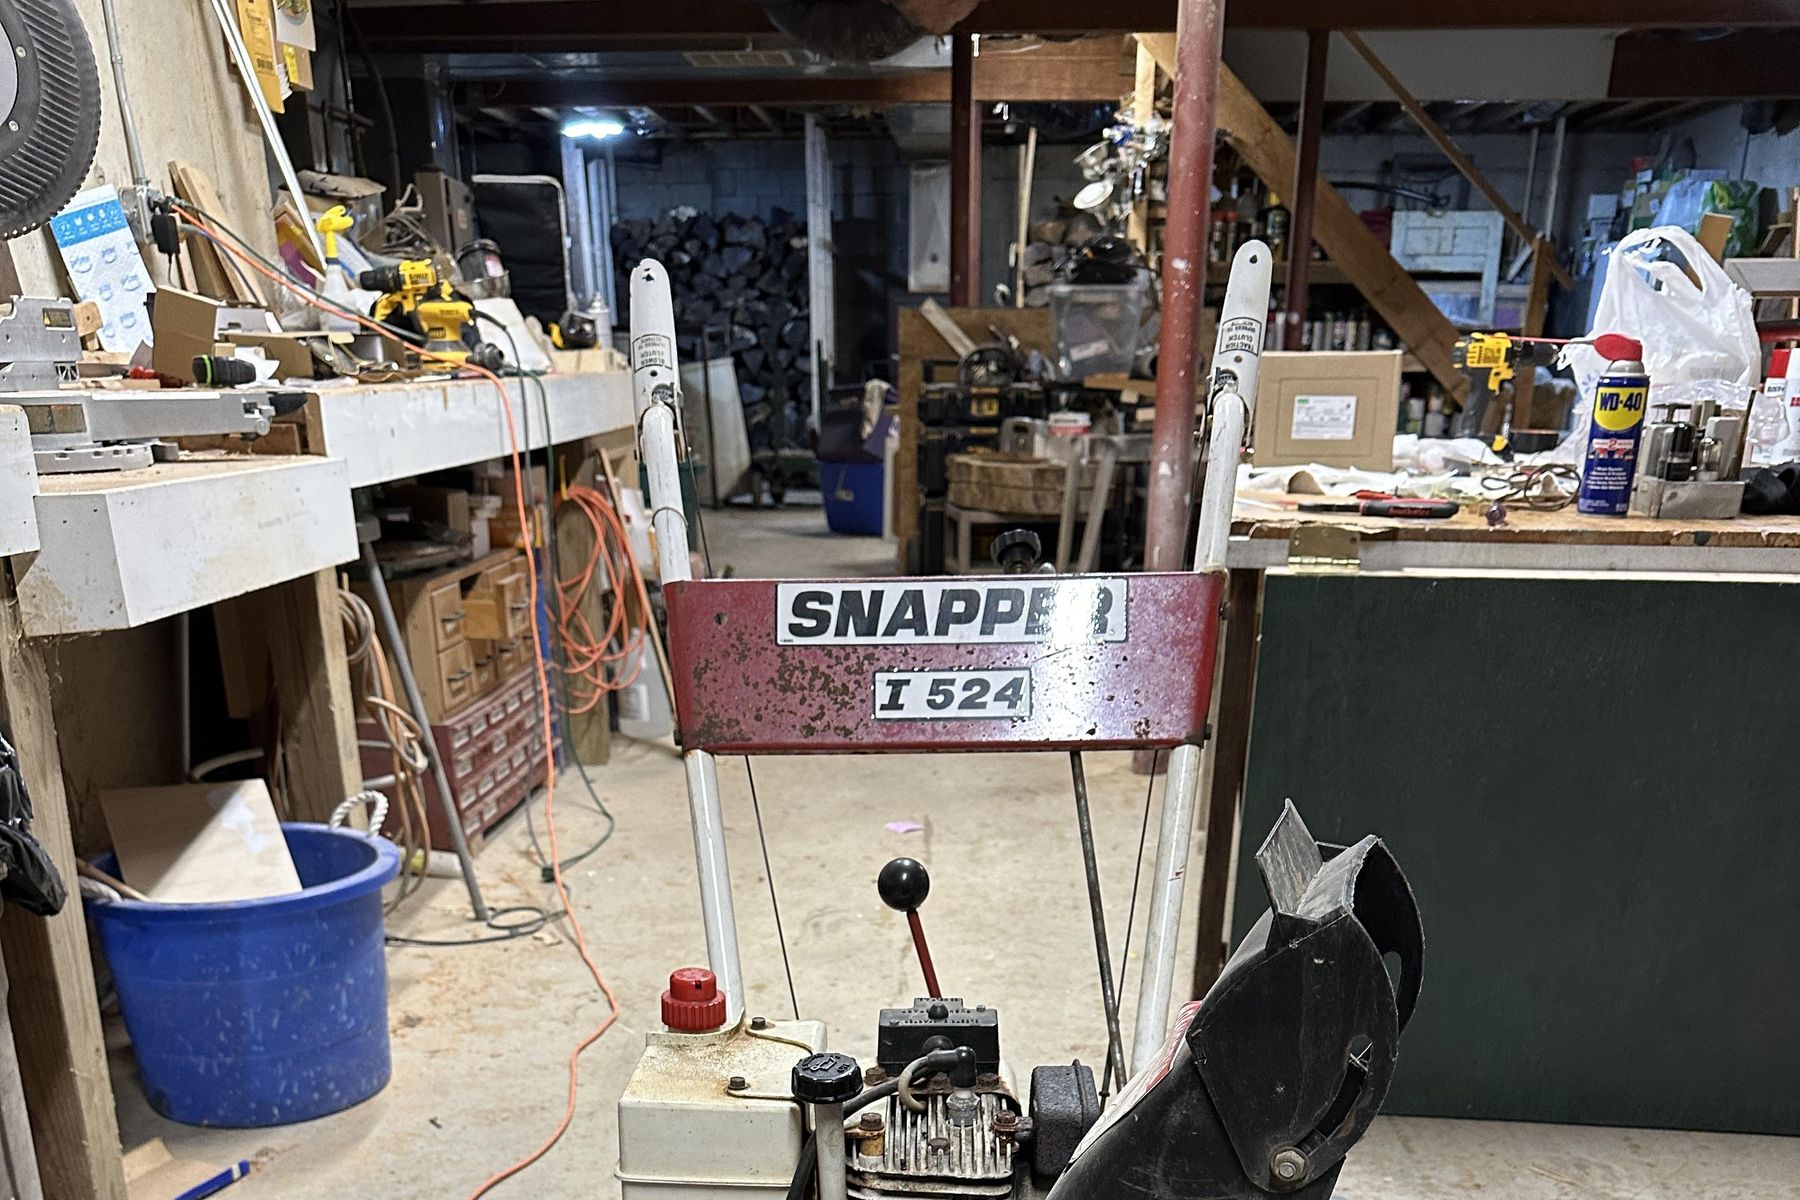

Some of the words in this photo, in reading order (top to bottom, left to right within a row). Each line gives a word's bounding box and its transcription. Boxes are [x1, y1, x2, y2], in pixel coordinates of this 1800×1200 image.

[1229, 334, 1253, 343] CLUTCH
[1599, 392, 1643, 412] WD-40
[879, 678, 912, 711] I
[926, 677, 1025, 711] 524
